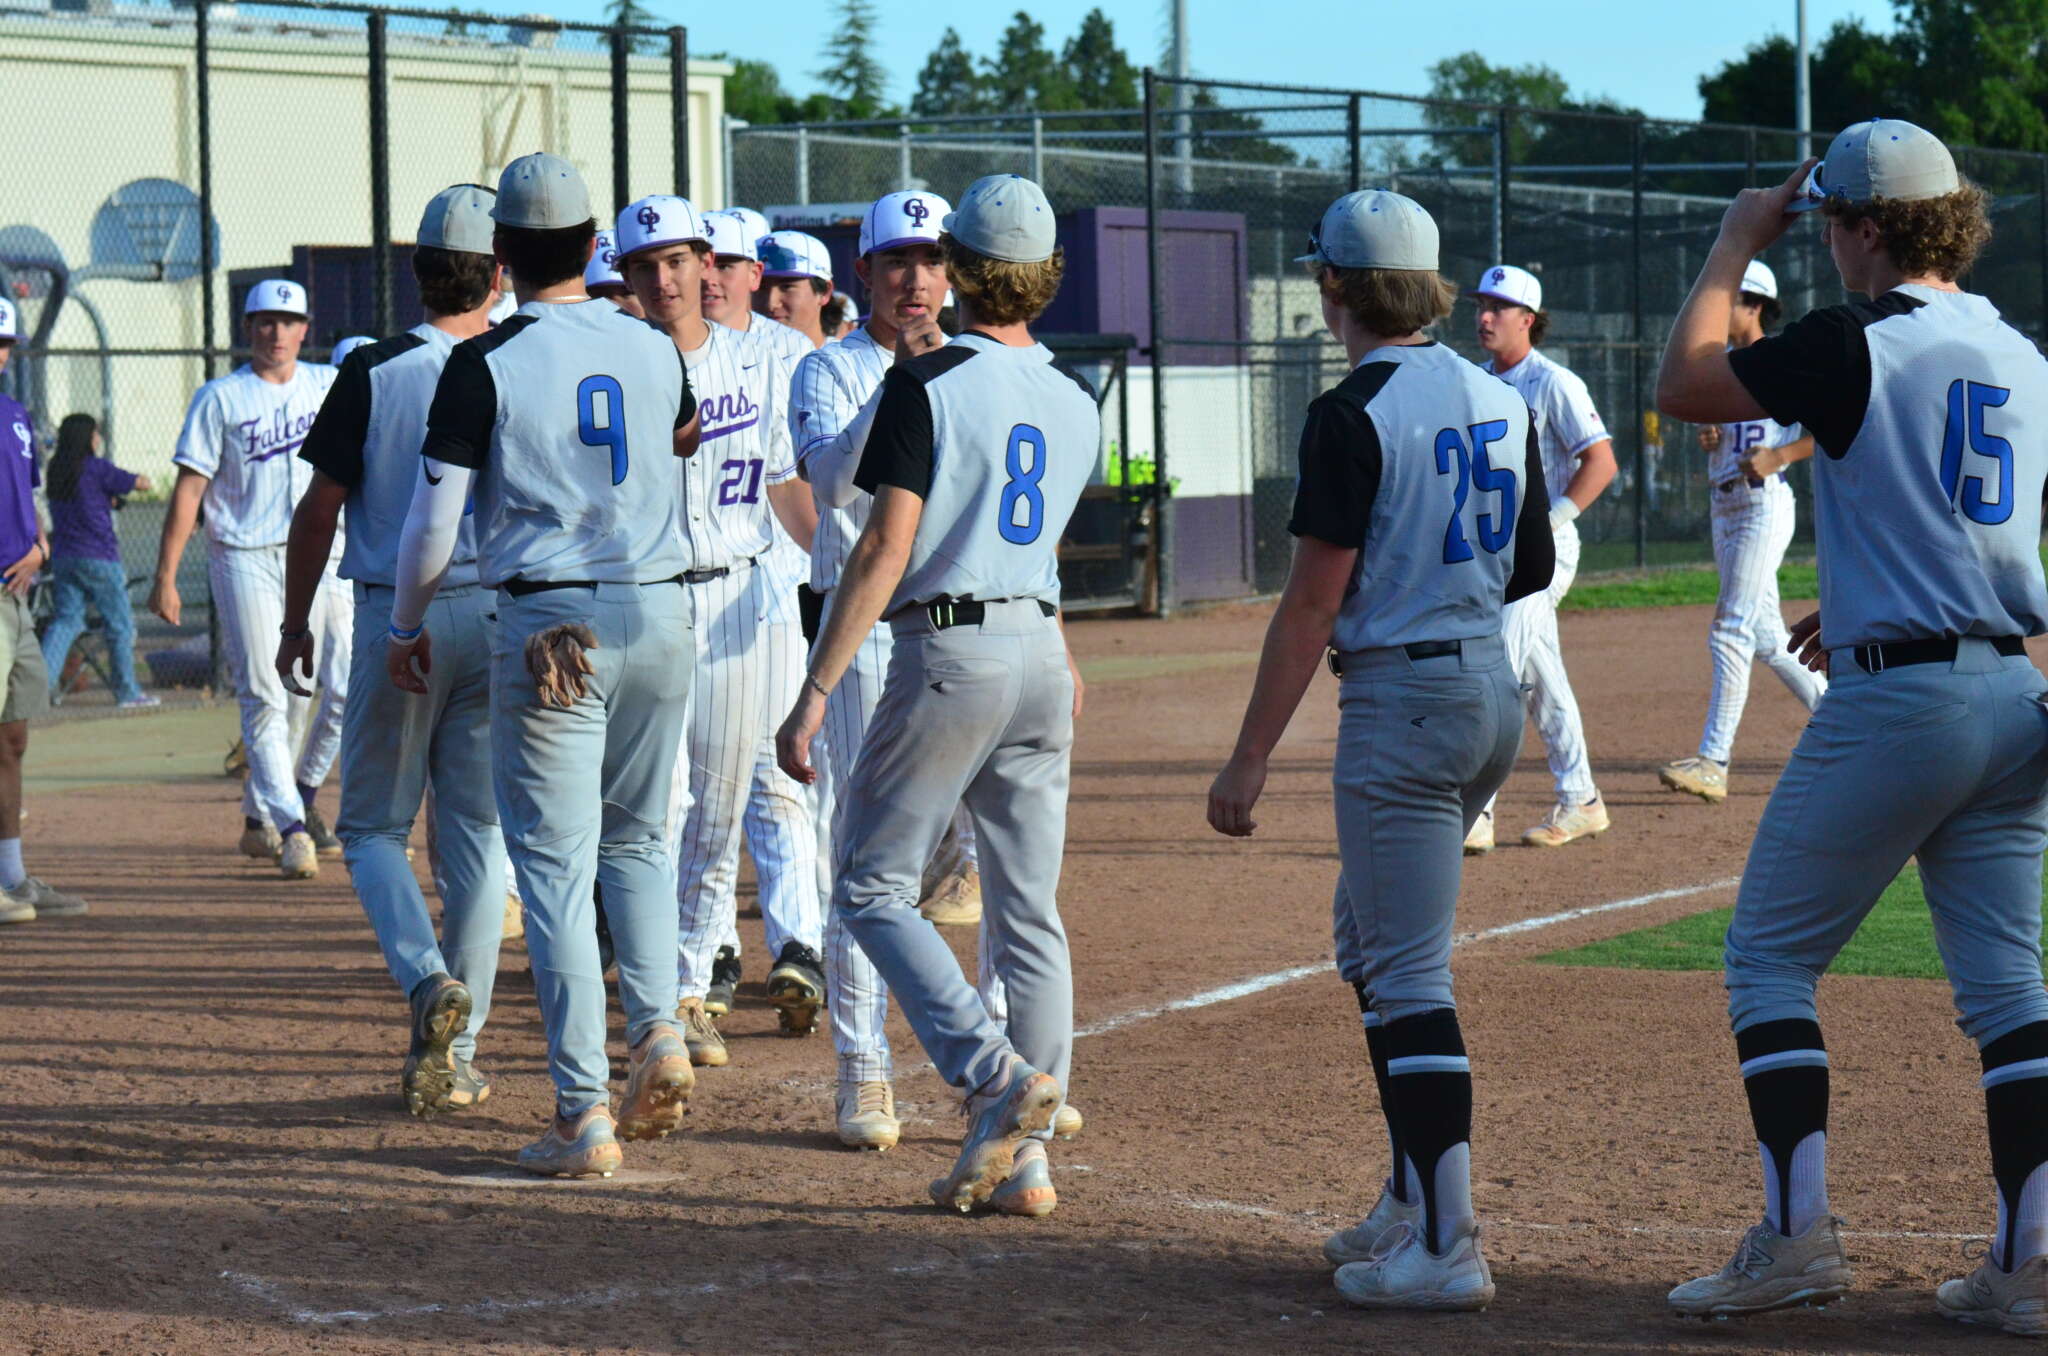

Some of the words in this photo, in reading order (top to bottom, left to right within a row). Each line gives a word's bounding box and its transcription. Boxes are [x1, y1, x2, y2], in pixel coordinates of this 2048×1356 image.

[576, 374, 629, 487] 9
[718, 458, 764, 506] 21
[997, 422, 1047, 547] 8
[1433, 418, 1517, 566] 25
[1939, 377, 2014, 526] 15
